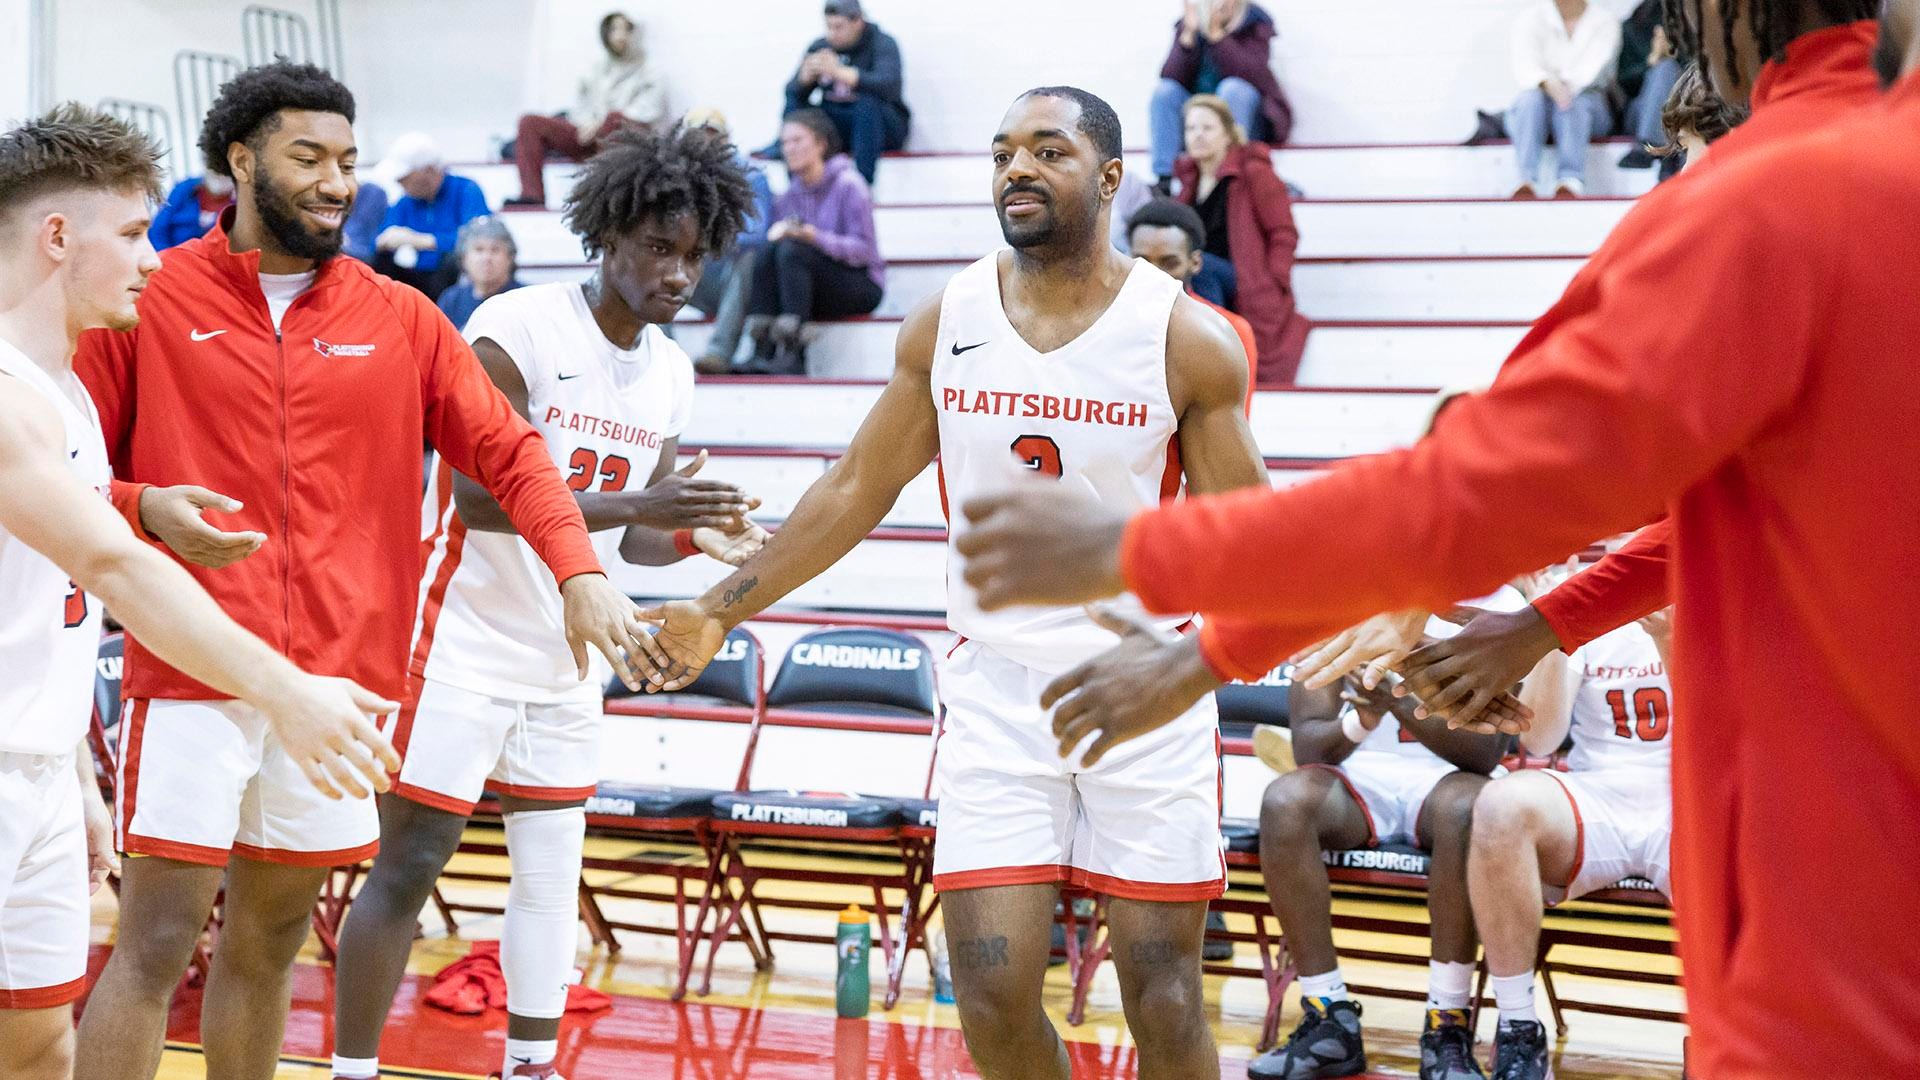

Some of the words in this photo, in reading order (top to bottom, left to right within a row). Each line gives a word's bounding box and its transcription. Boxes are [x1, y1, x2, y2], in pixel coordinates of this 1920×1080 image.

[943, 387, 1148, 427] PLATTSBURGH
[791, 642, 922, 670] CARDINALS
[1583, 662, 1663, 679] LATTSBU
[1605, 687, 1669, 742] 10
[731, 803, 848, 827] PLATTSBURGH
[1320, 849, 1425, 873] ATTSBURGH
